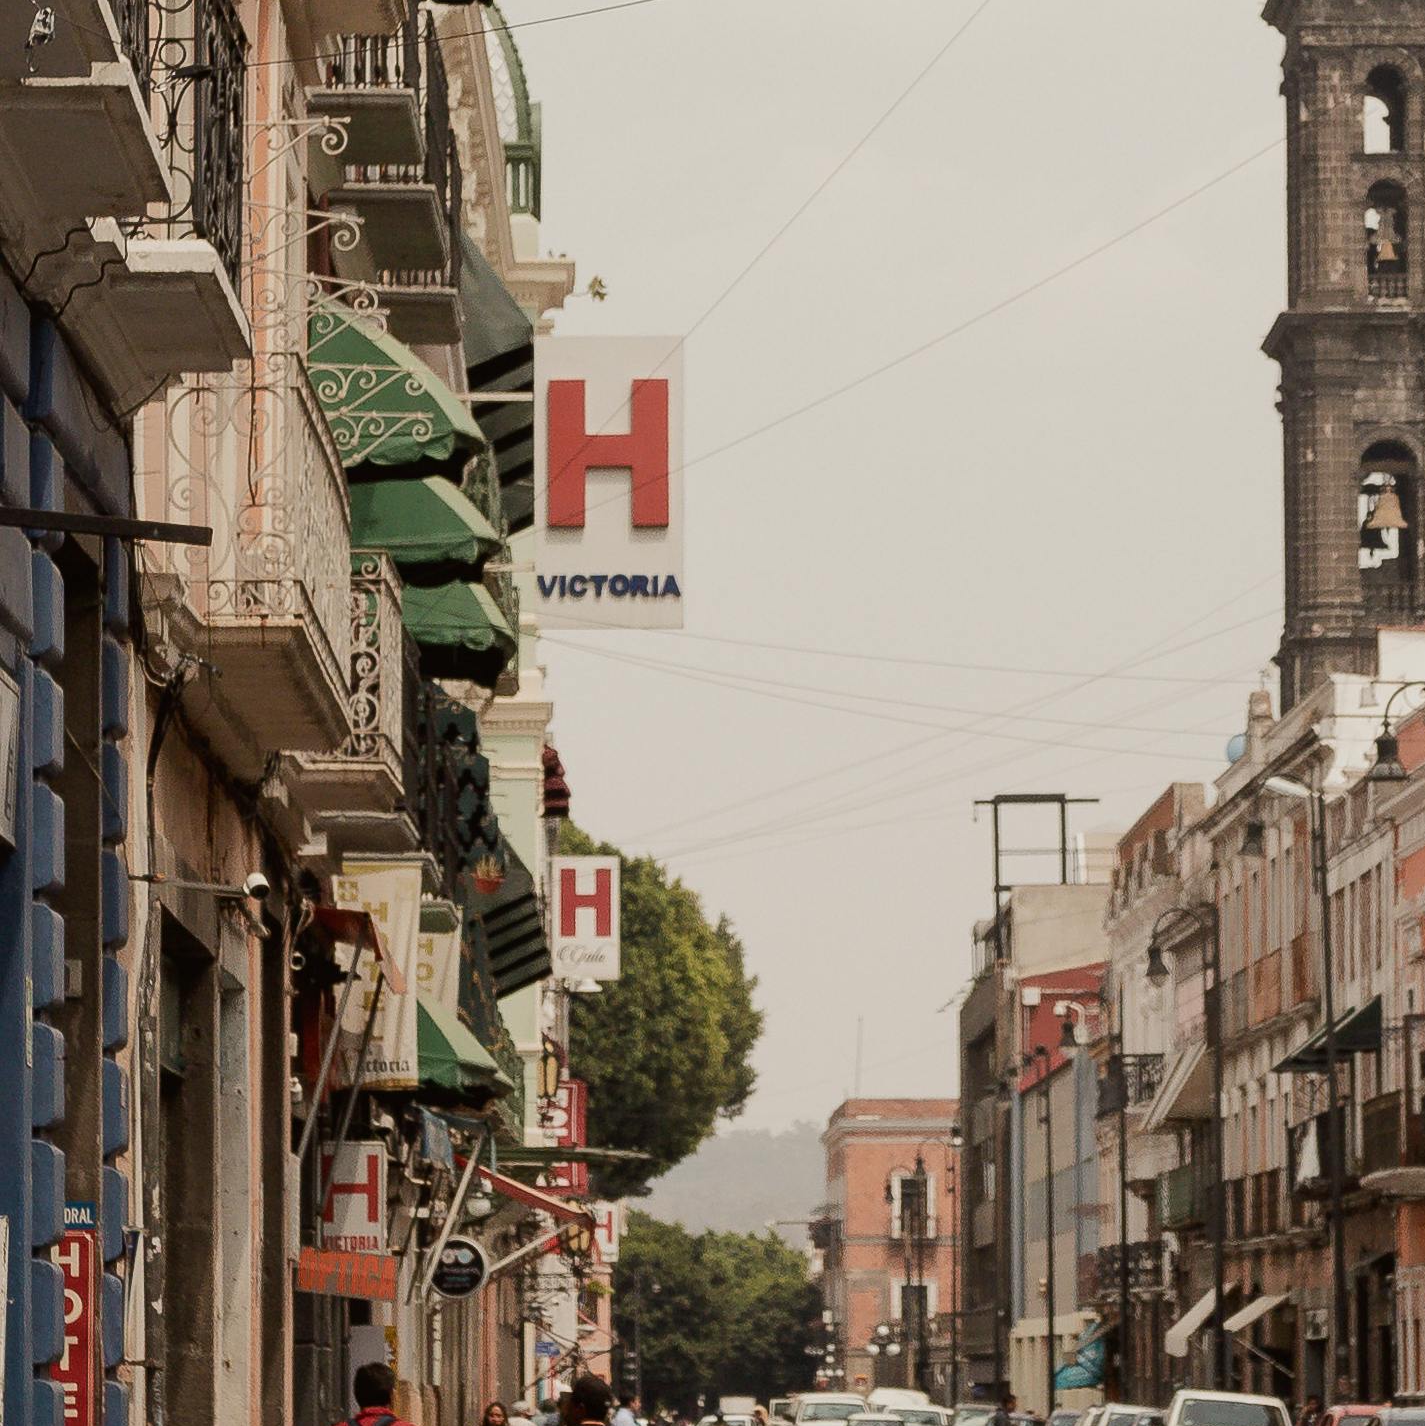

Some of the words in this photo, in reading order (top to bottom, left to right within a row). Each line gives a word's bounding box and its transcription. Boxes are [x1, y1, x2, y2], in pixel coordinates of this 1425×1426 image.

[547, 379, 670, 529] H
[537, 574, 681, 600] VICTORIA
[560, 868, 612, 938] H
[322, 1154, 379, 1223] H
